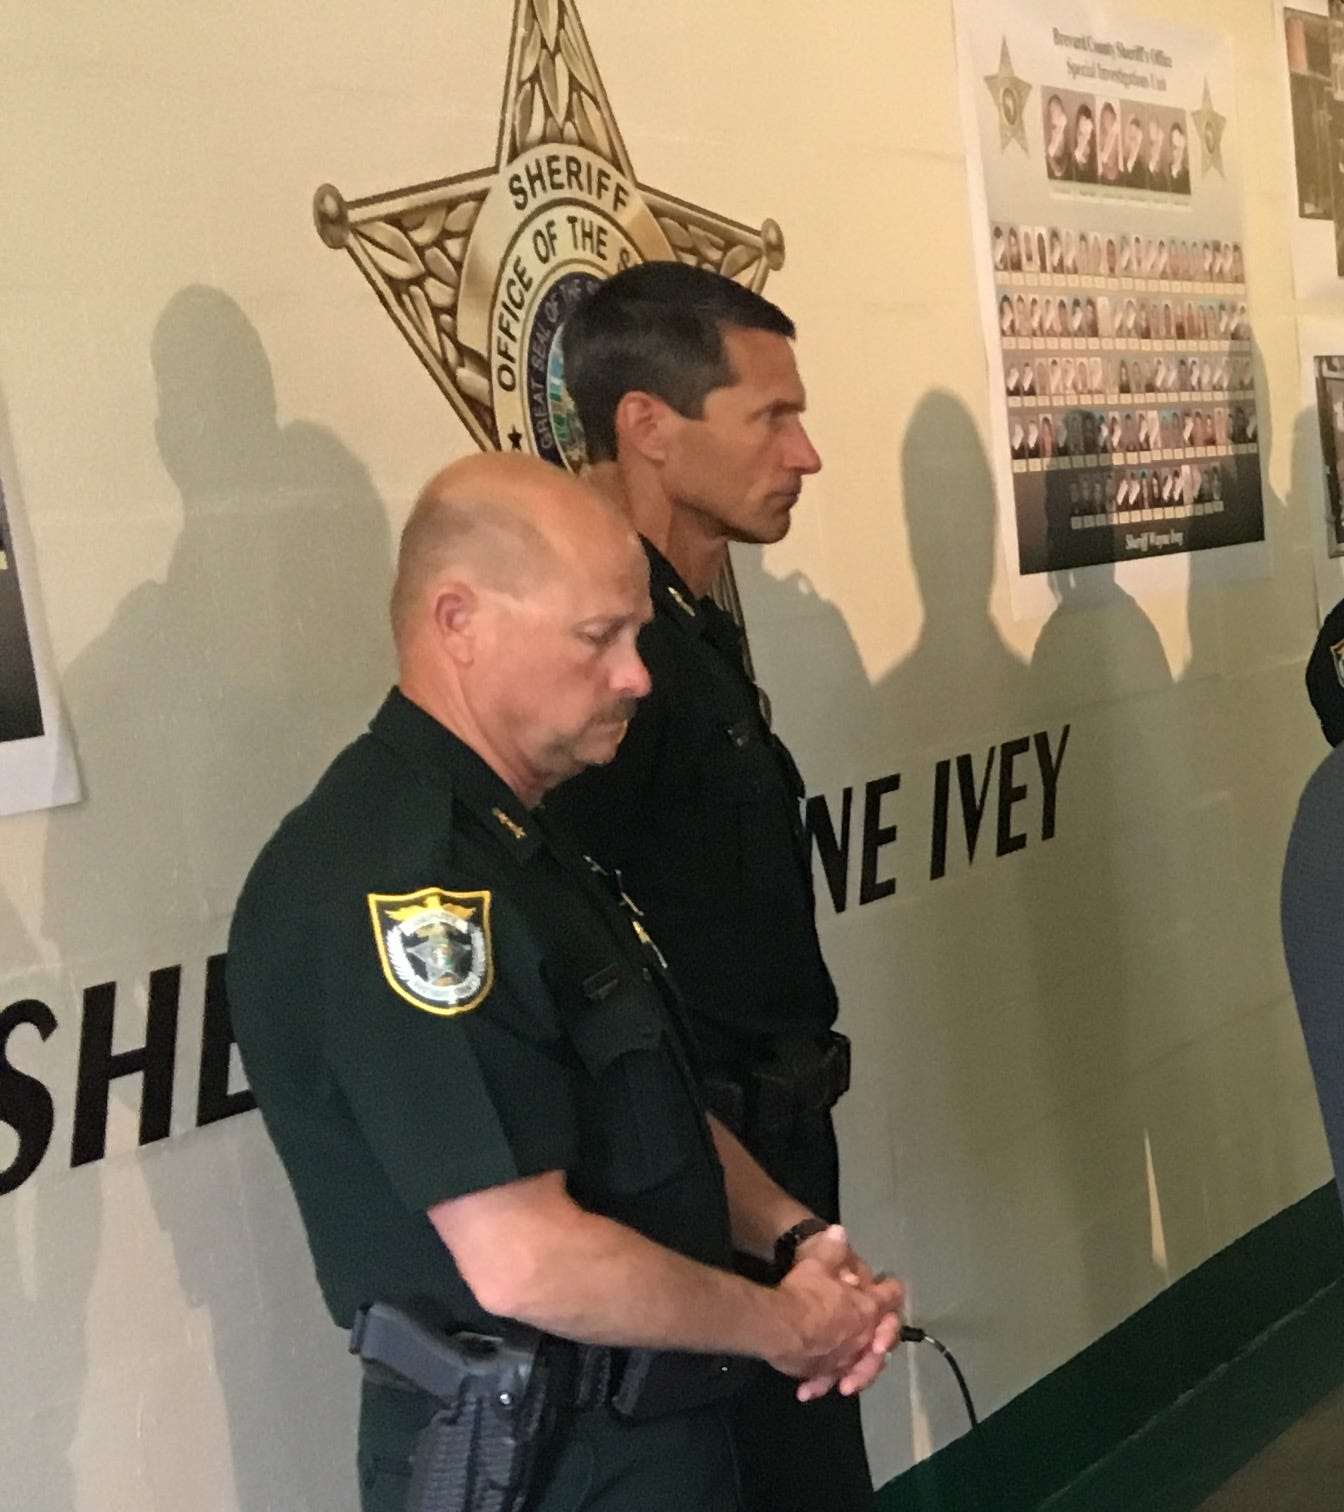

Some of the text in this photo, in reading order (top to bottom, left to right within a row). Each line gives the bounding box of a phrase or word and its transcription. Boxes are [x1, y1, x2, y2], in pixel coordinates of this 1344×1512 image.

[508, 154, 629, 211] SHERIFF
[498, 255, 535, 392] OFFICE
[533, 219, 557, 264] OF
[566, 215, 608, 261] THE
[930, 724, 1071, 881] IVEY
